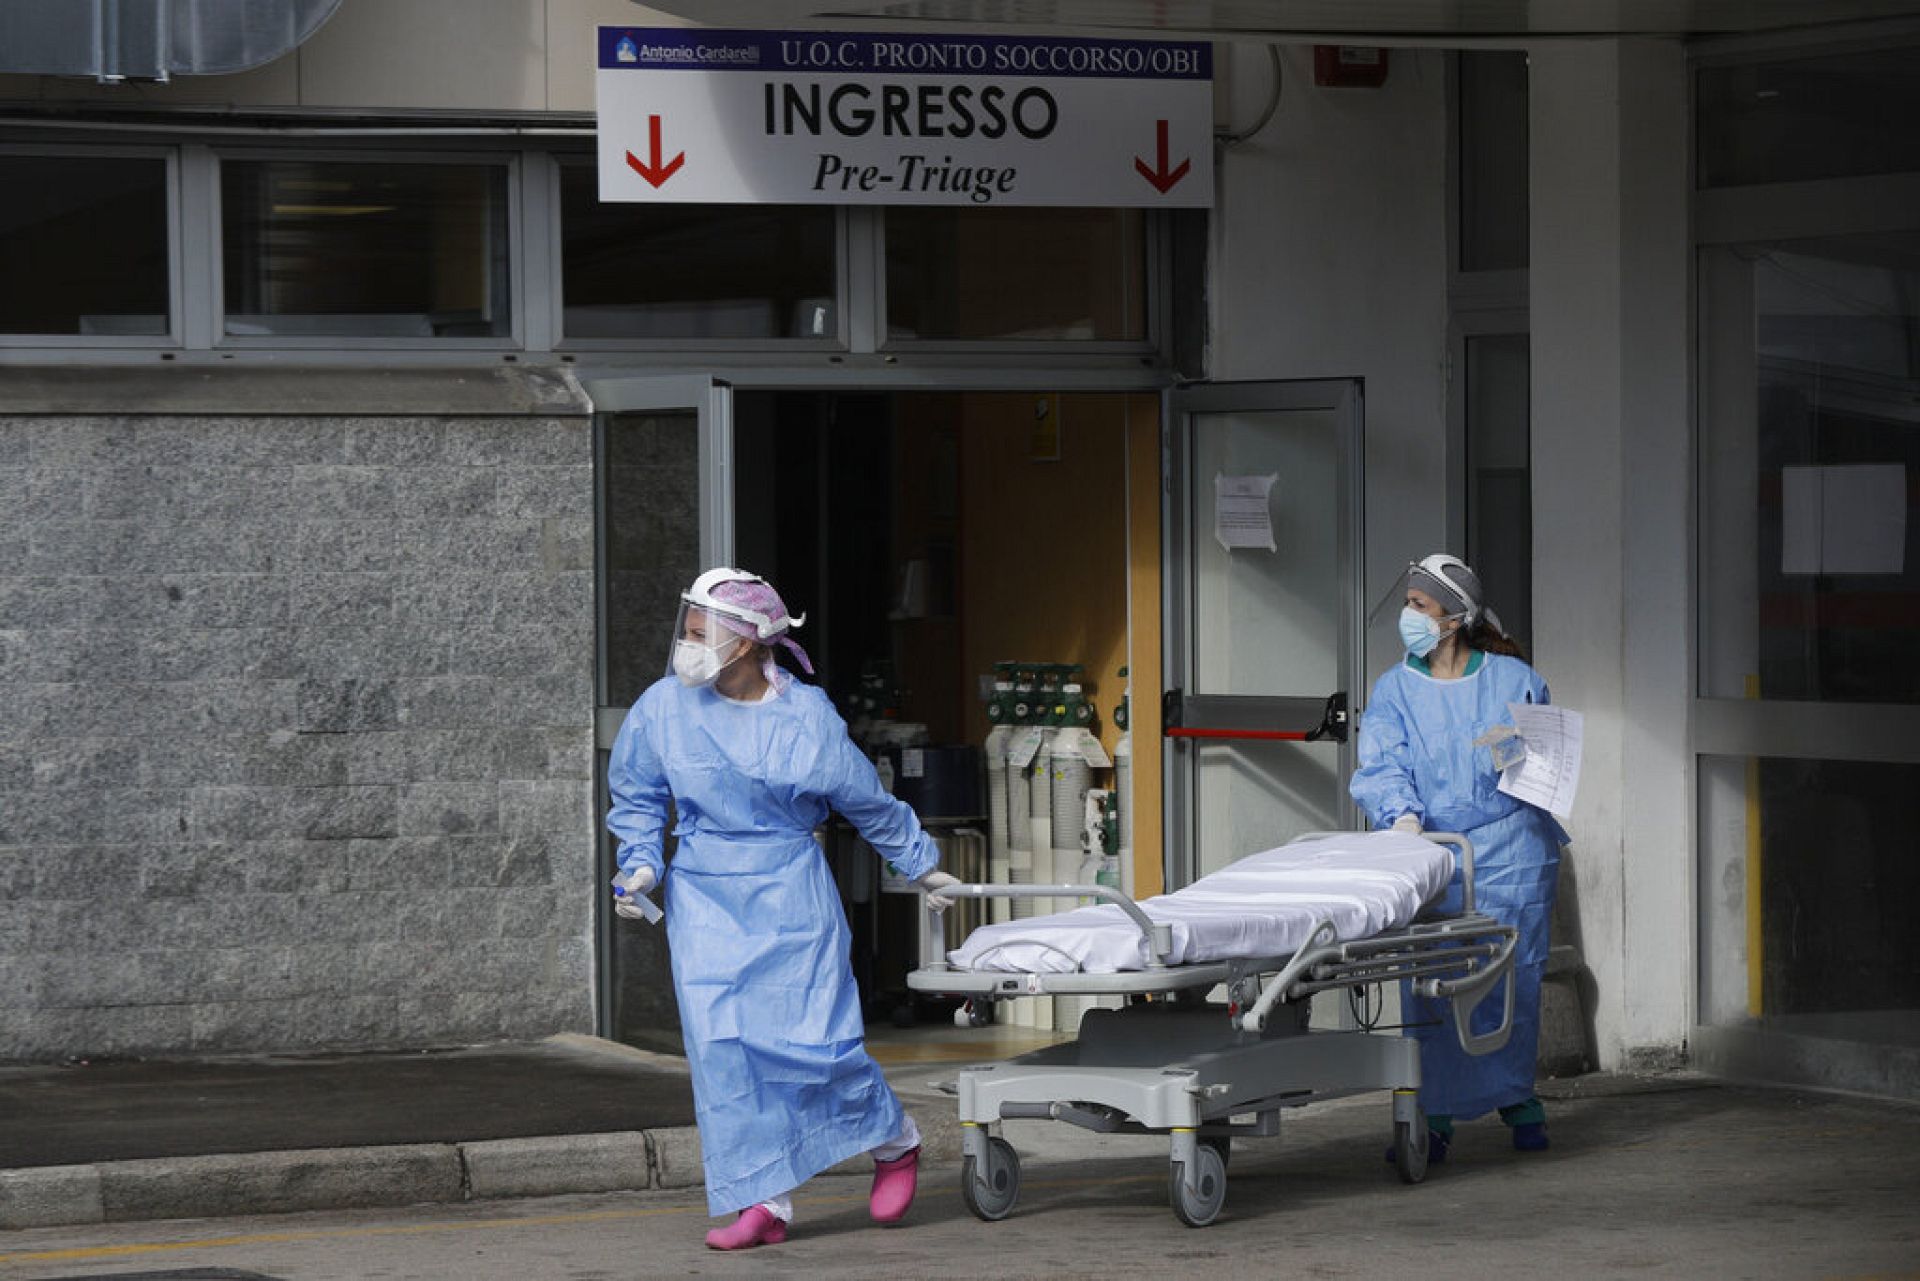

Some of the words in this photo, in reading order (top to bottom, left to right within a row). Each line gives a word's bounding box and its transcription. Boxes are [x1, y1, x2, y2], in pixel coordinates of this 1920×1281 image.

[640, 44, 694, 58] Antonio
[697, 45, 760, 59] Cardarelli
[781, 41, 864, 66] U.O.C.
[872, 42, 987, 69] PRONTO
[994, 44, 1200, 73] SOCCORSO/OBI
[764, 83, 1058, 139] INGRESSO
[813, 154, 1017, 202] Pre-Triage
